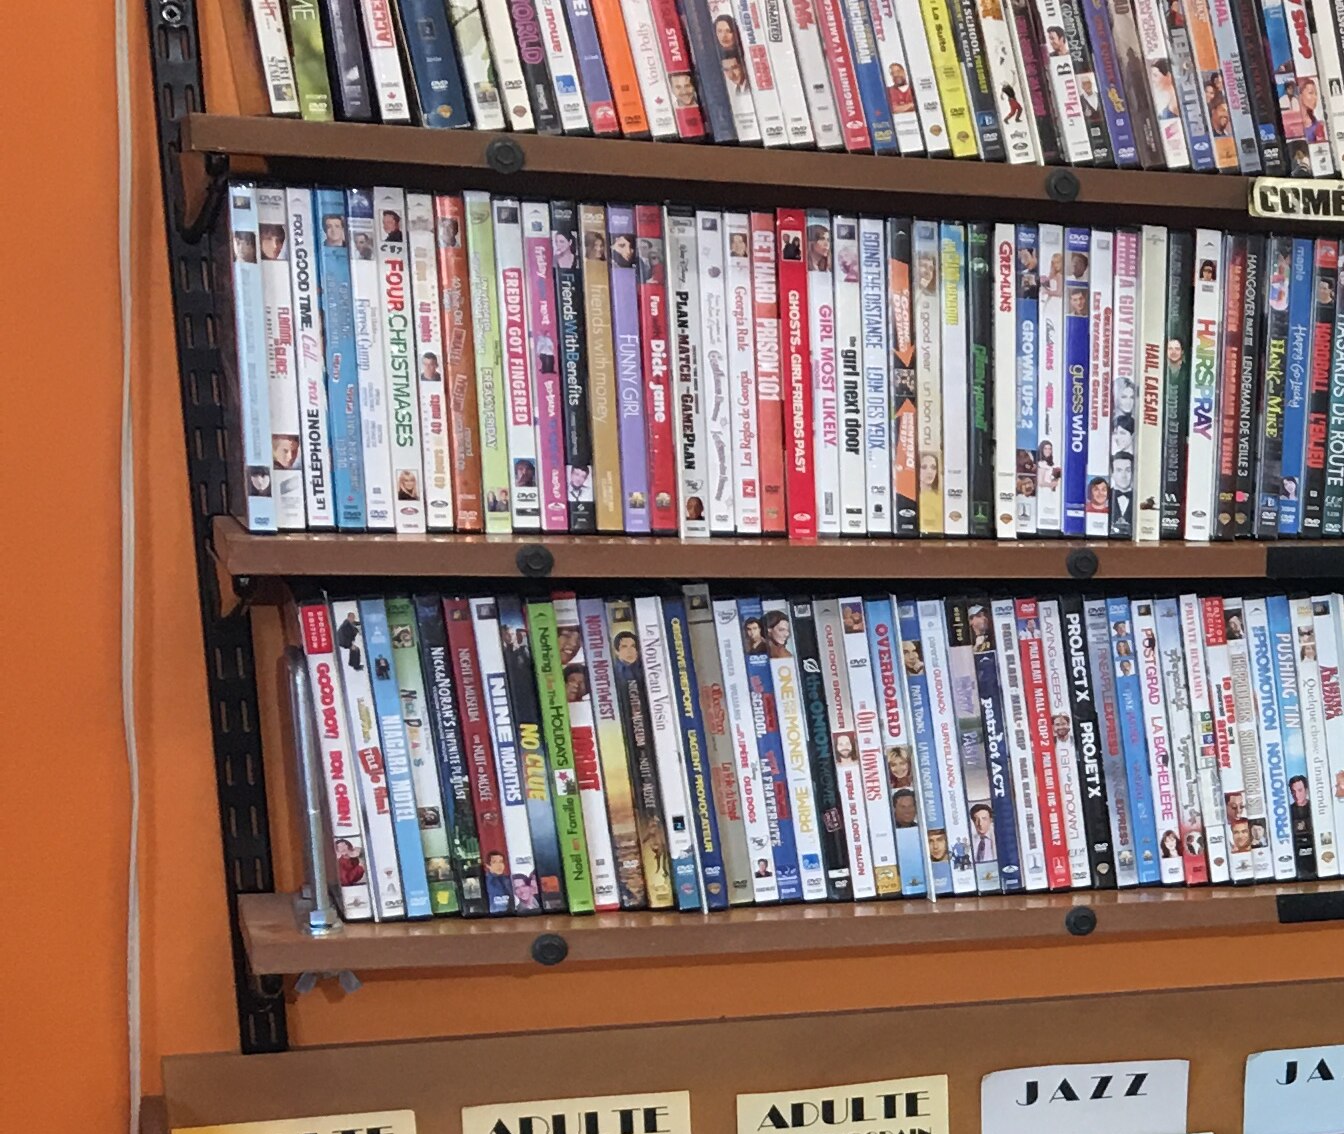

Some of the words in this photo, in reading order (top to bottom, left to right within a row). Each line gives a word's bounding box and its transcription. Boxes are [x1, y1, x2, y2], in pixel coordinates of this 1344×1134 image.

[384, 259, 404, 315] FOUR
[504, 271, 522, 324] FREDDY
[999, 240, 1014, 313] GREMLINS
[511, 326, 524, 353] GOT
[818, 304, 833, 342] GIRL
[388, 314, 413, 448] CHRISTMASES
[619, 334, 639, 382] FUNNY
[820, 346, 836, 393] MOST
[1192, 318, 1217, 440] HAIRSPRAY
[512, 356, 527, 424] FINGERED
[622, 383, 640, 419] GIRL
[821, 397, 838, 447] LIKELY
[1066, 613, 1088, 689] PROJECT
[1276, 632, 1296, 699] PUSHING
[875, 623, 901, 738] OVERBOARD
[1076, 691, 1091, 702] X
[490, 676, 512, 742] NINE
[550, 705, 569, 767] HOLIDAYS
[1283, 702, 1300, 728] TIN
[500, 746, 522, 804] MONTHS
[1079, 721, 1100, 782] PROJET
[1088, 785, 1102, 799] X
[757, 1090, 931, 1131] ADULTE
[1015, 1073, 1149, 1106] JAZZ
